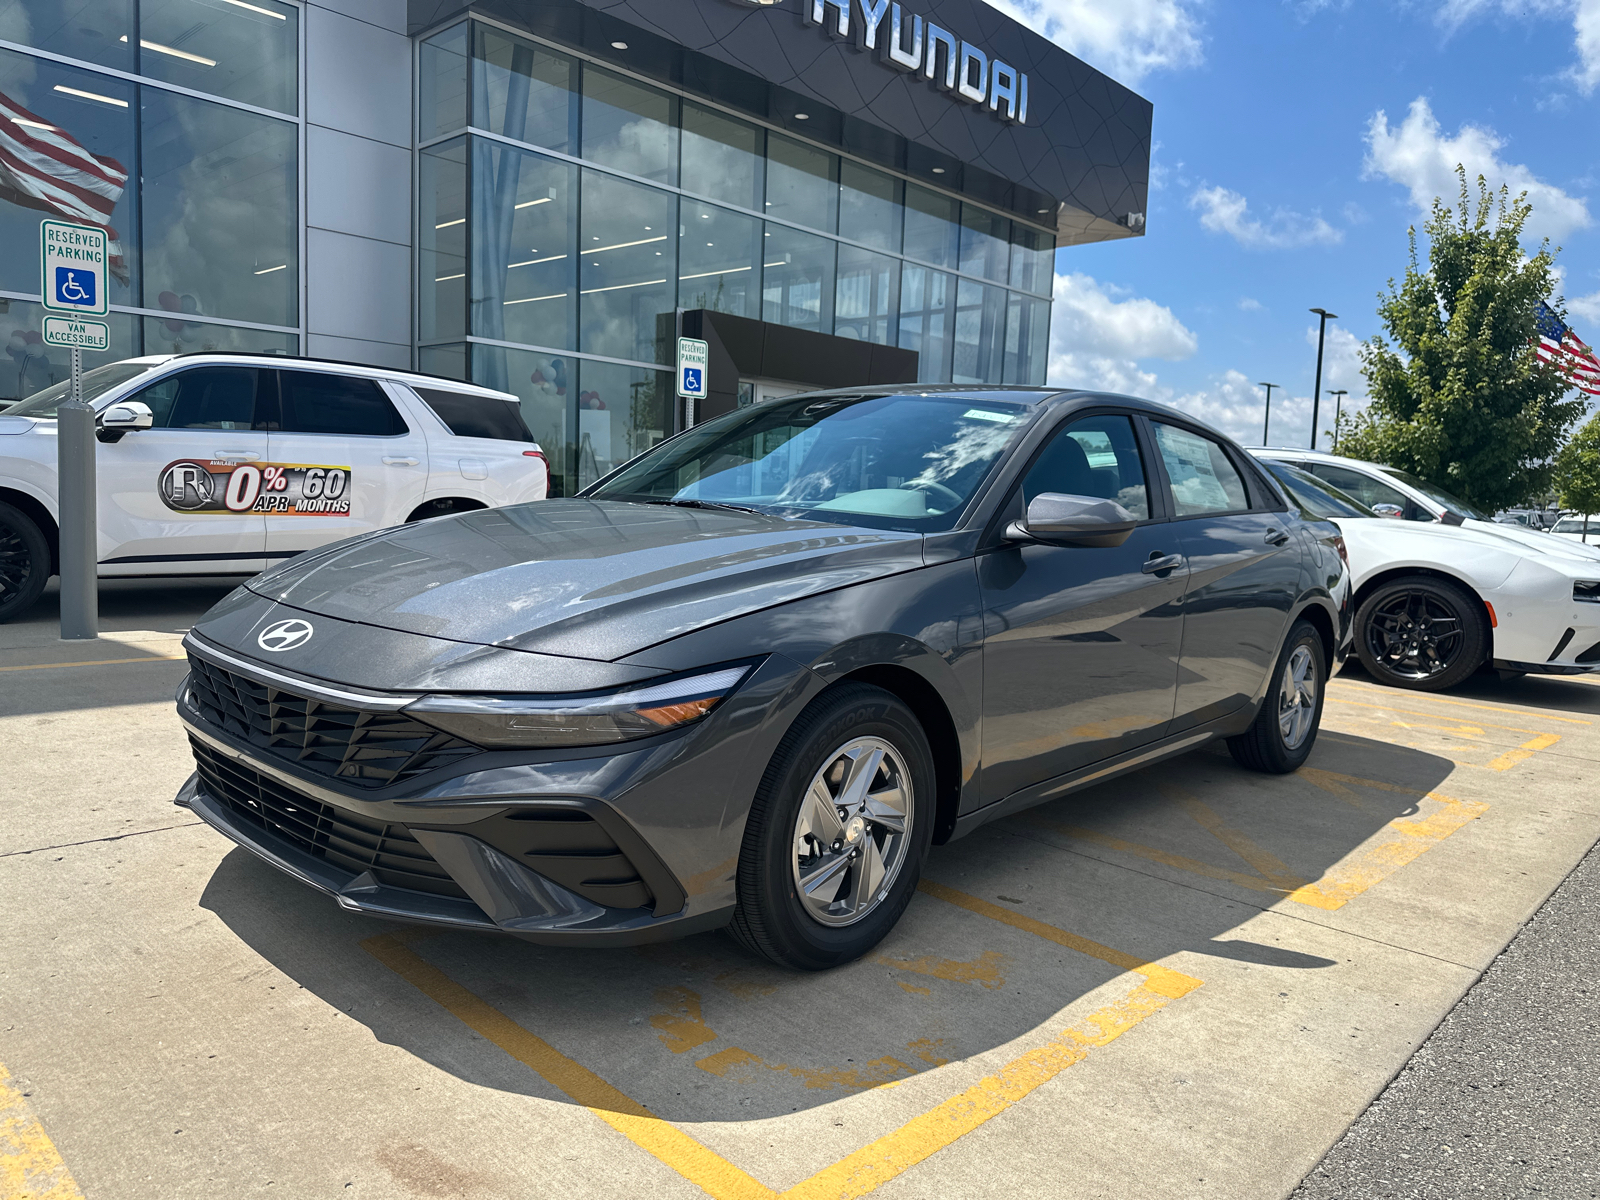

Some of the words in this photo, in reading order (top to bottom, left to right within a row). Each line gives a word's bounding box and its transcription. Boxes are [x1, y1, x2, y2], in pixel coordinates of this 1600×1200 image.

[48, 229, 101, 248] RESERVED
[48, 244, 102, 263] PARKING
[68, 323, 86, 333] VAN
[48, 332, 104, 345] ACCESSIBLE
[681, 343, 705, 355] RESERVED
[681, 353, 705, 364] PARKING
[302, 468, 346, 500] 60
[254, 496, 289, 512] APR
[295, 499, 350, 514] MONTHS
